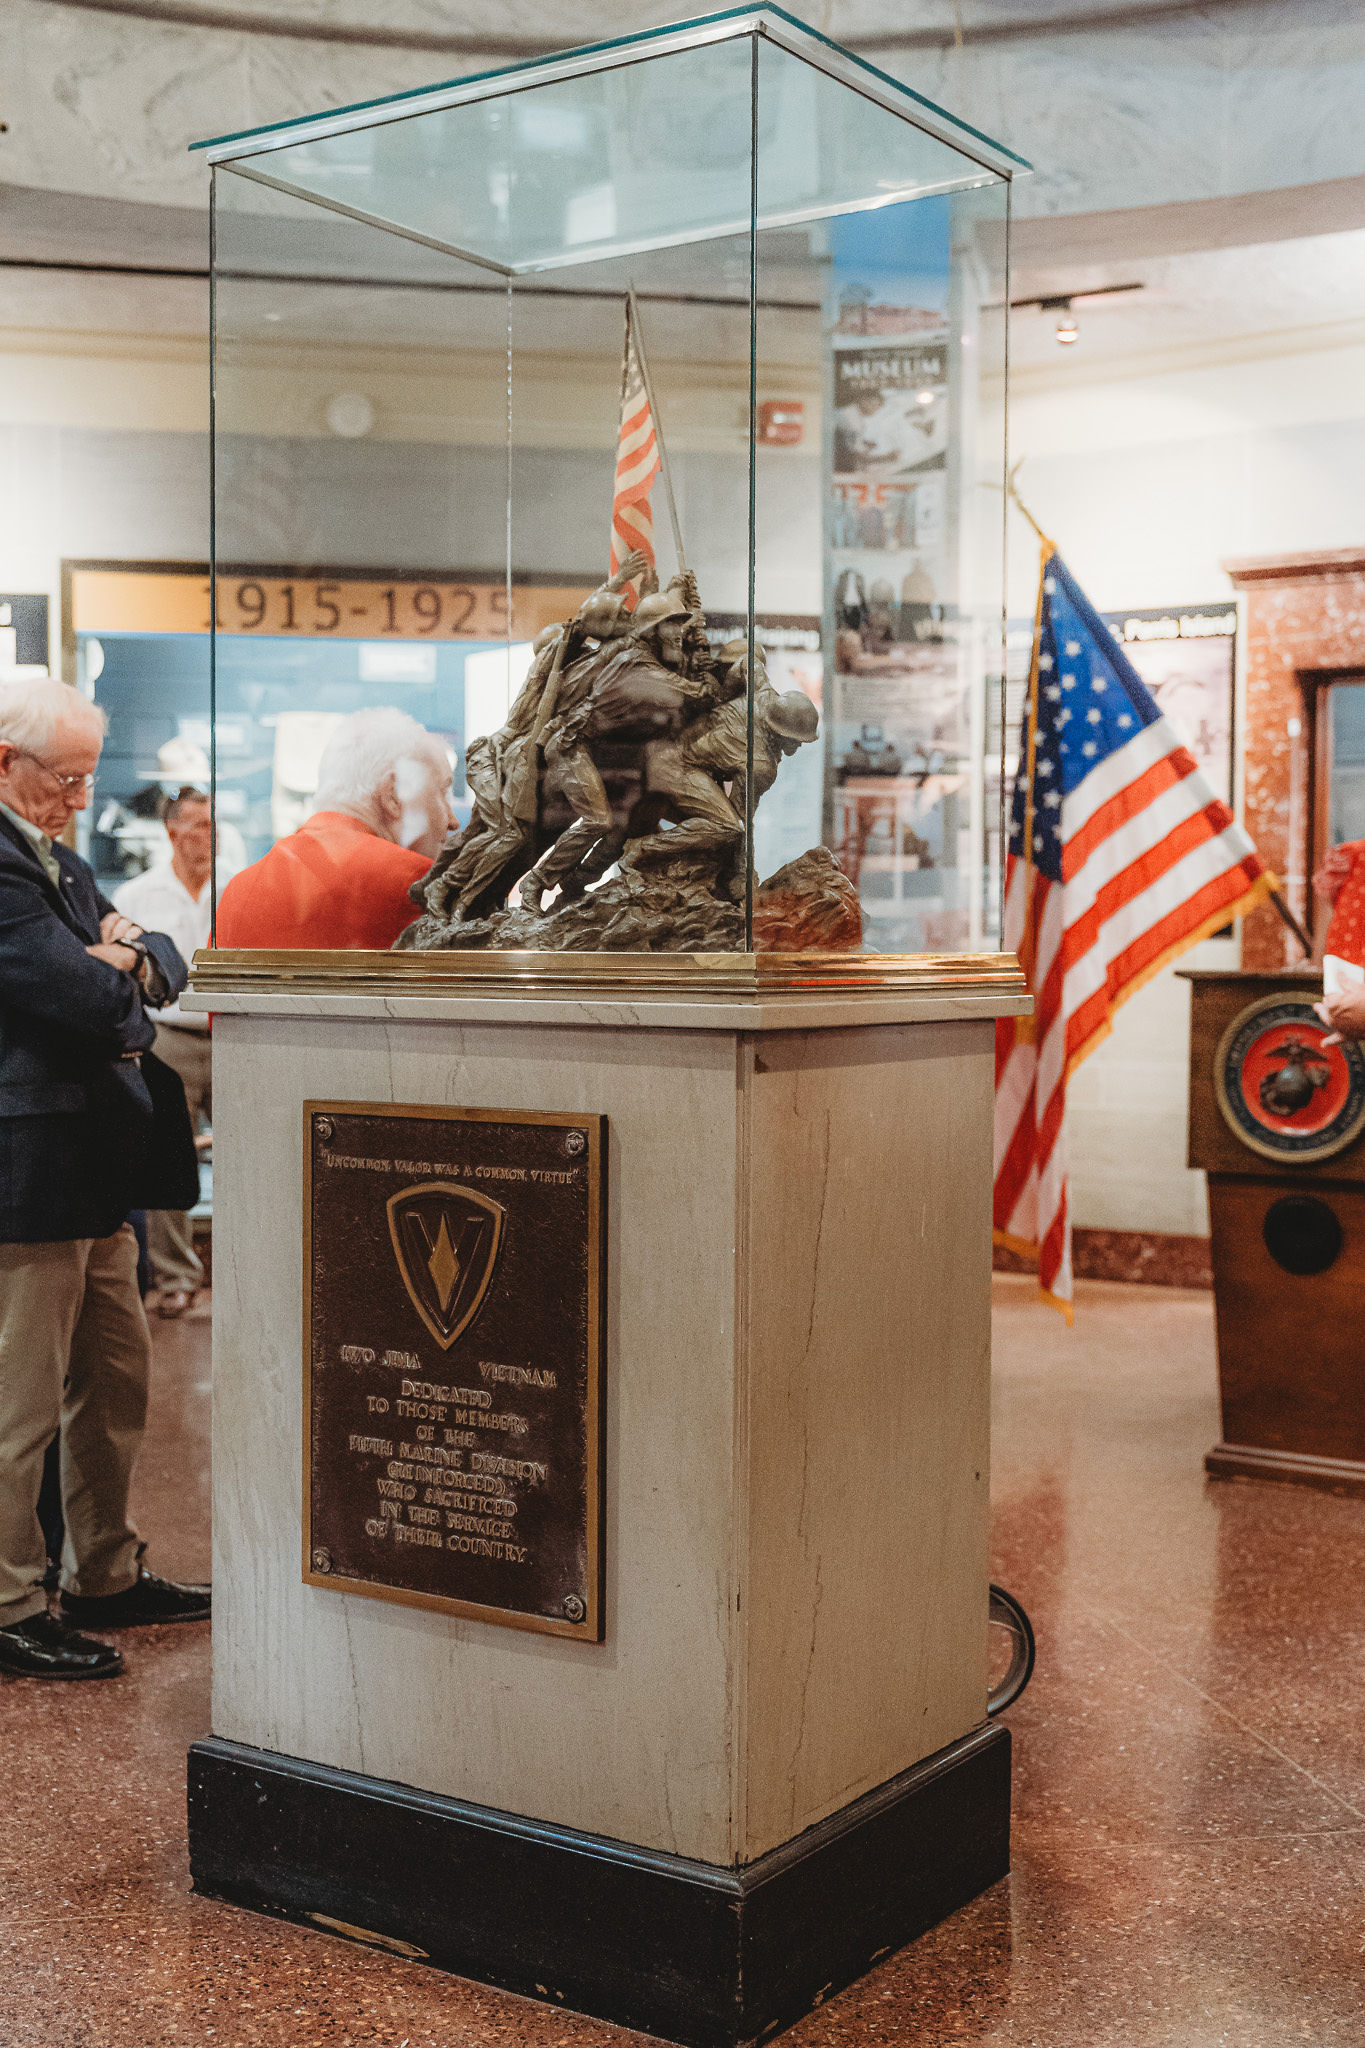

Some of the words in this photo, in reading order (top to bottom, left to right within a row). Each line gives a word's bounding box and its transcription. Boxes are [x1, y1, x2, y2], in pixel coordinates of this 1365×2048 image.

[202, 580, 515, 637] 1915-1925
[395, 1159, 431, 1175] VALOR
[435, 1163, 459, 1176] WAS
[464, 1166, 472, 1177] A
[475, 1167, 527, 1182] COMMON
[340, 1345, 375, 1364] IWO
[381, 1350, 422, 1370] JIMA
[478, 1361, 558, 1388] VIETNAM
[401, 1378, 492, 1409] DEDICATED
[366, 1395, 389, 1413] TO
[396, 1399, 448, 1422] THOSE
[455, 1408, 529, 1434] MEMBERS
[416, 1425, 436, 1441] OF
[443, 1428, 477, 1447] THE
[349, 1435, 393, 1457] FIFTH
[399, 1441, 462, 1468] MARINE
[471, 1453, 549, 1481] DIVISION
[387, 1461, 507, 1495] (REINFORCED)
[377, 1479, 416, 1500] WHO
[424, 1488, 518, 1518] SACRIFICED
[365, 1520, 388, 1537] OF
[394, 1524, 442, 1548] THEIR
[379, 1501, 401, 1518] IN
[408, 1507, 440, 1527] THE
[446, 1512, 513, 1540] SERVICE
